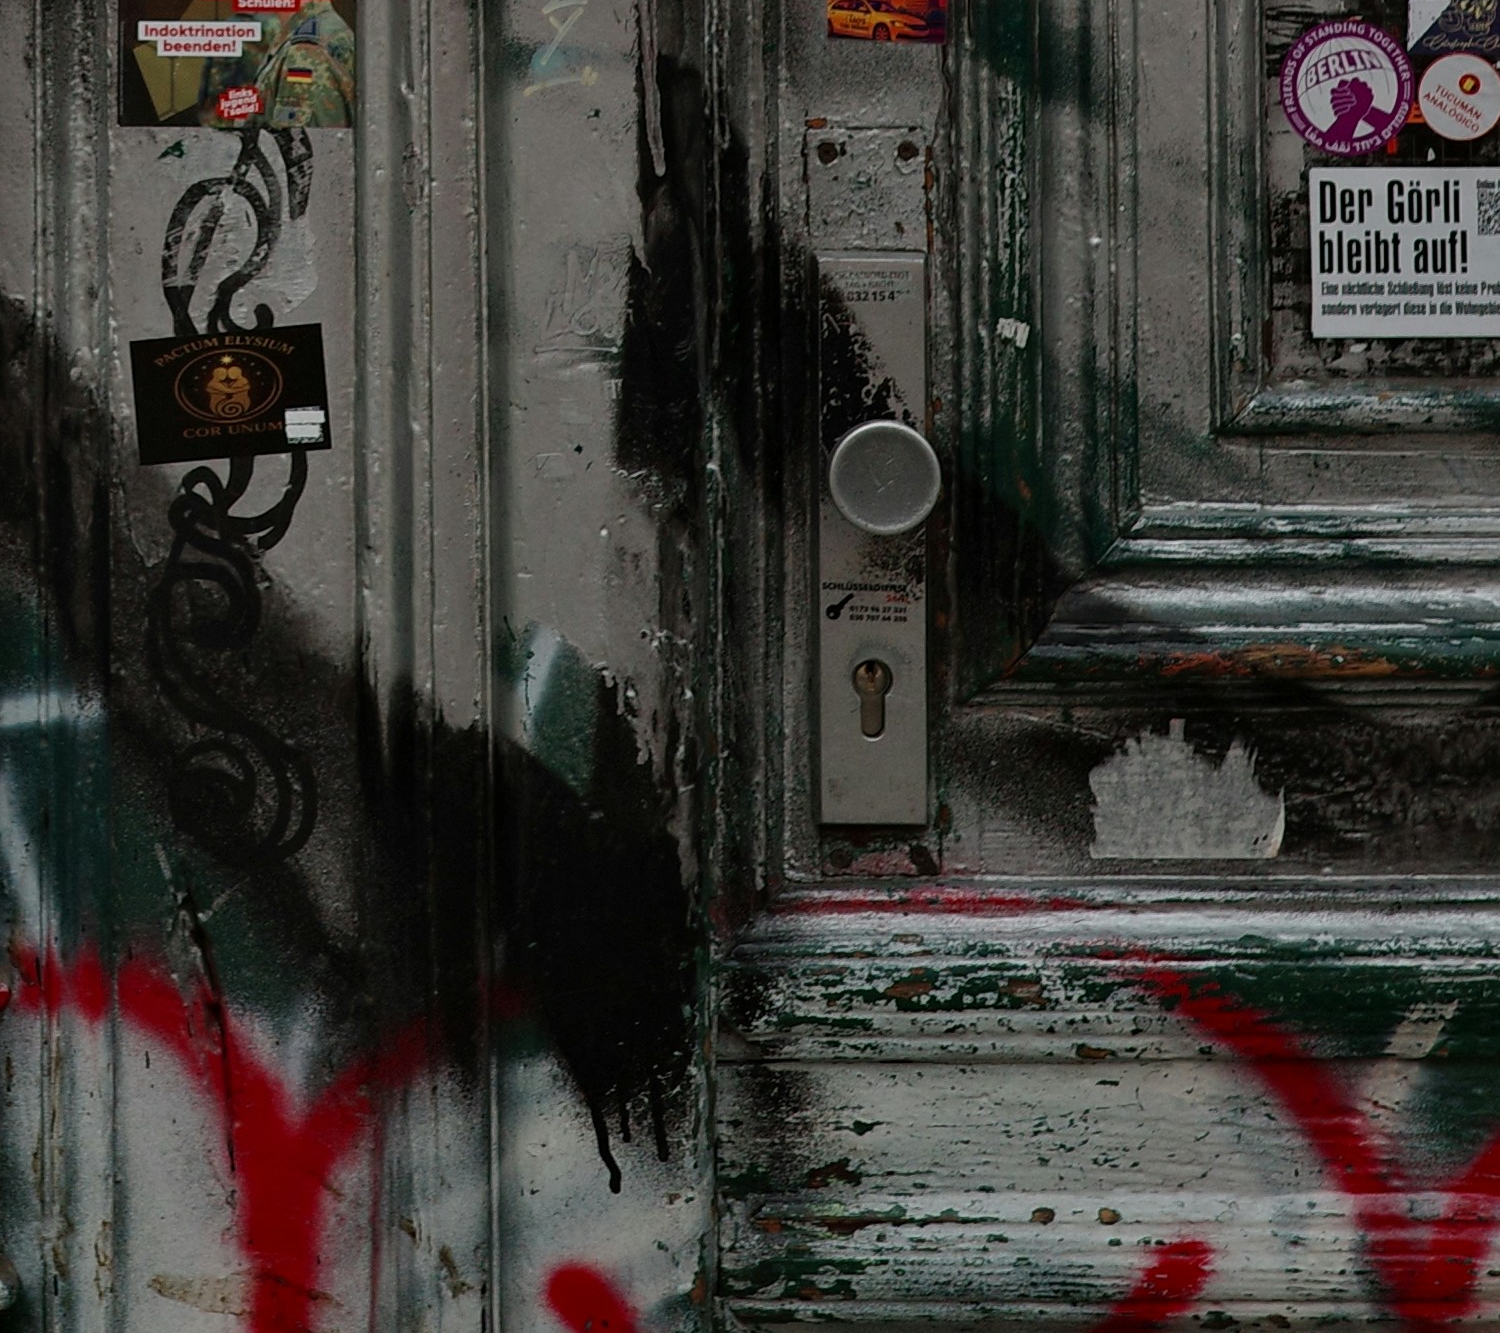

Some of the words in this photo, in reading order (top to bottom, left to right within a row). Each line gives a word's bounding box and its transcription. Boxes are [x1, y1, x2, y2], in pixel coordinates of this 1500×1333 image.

[144, 24, 255, 38] Indoktrination
[164, 41, 236, 52] beenden!
[1319, 180, 1372, 224] Der
[1387, 180, 1460, 224] Görli
[1320, 231, 1401, 274] bleibt
[1414, 231, 1468, 274] auf!
[154, 333, 221, 368] PACTUM
[223, 335, 296, 357] ELYSIUM
[182, 424, 222, 440] COR
[228, 419, 283, 437] UNUM
